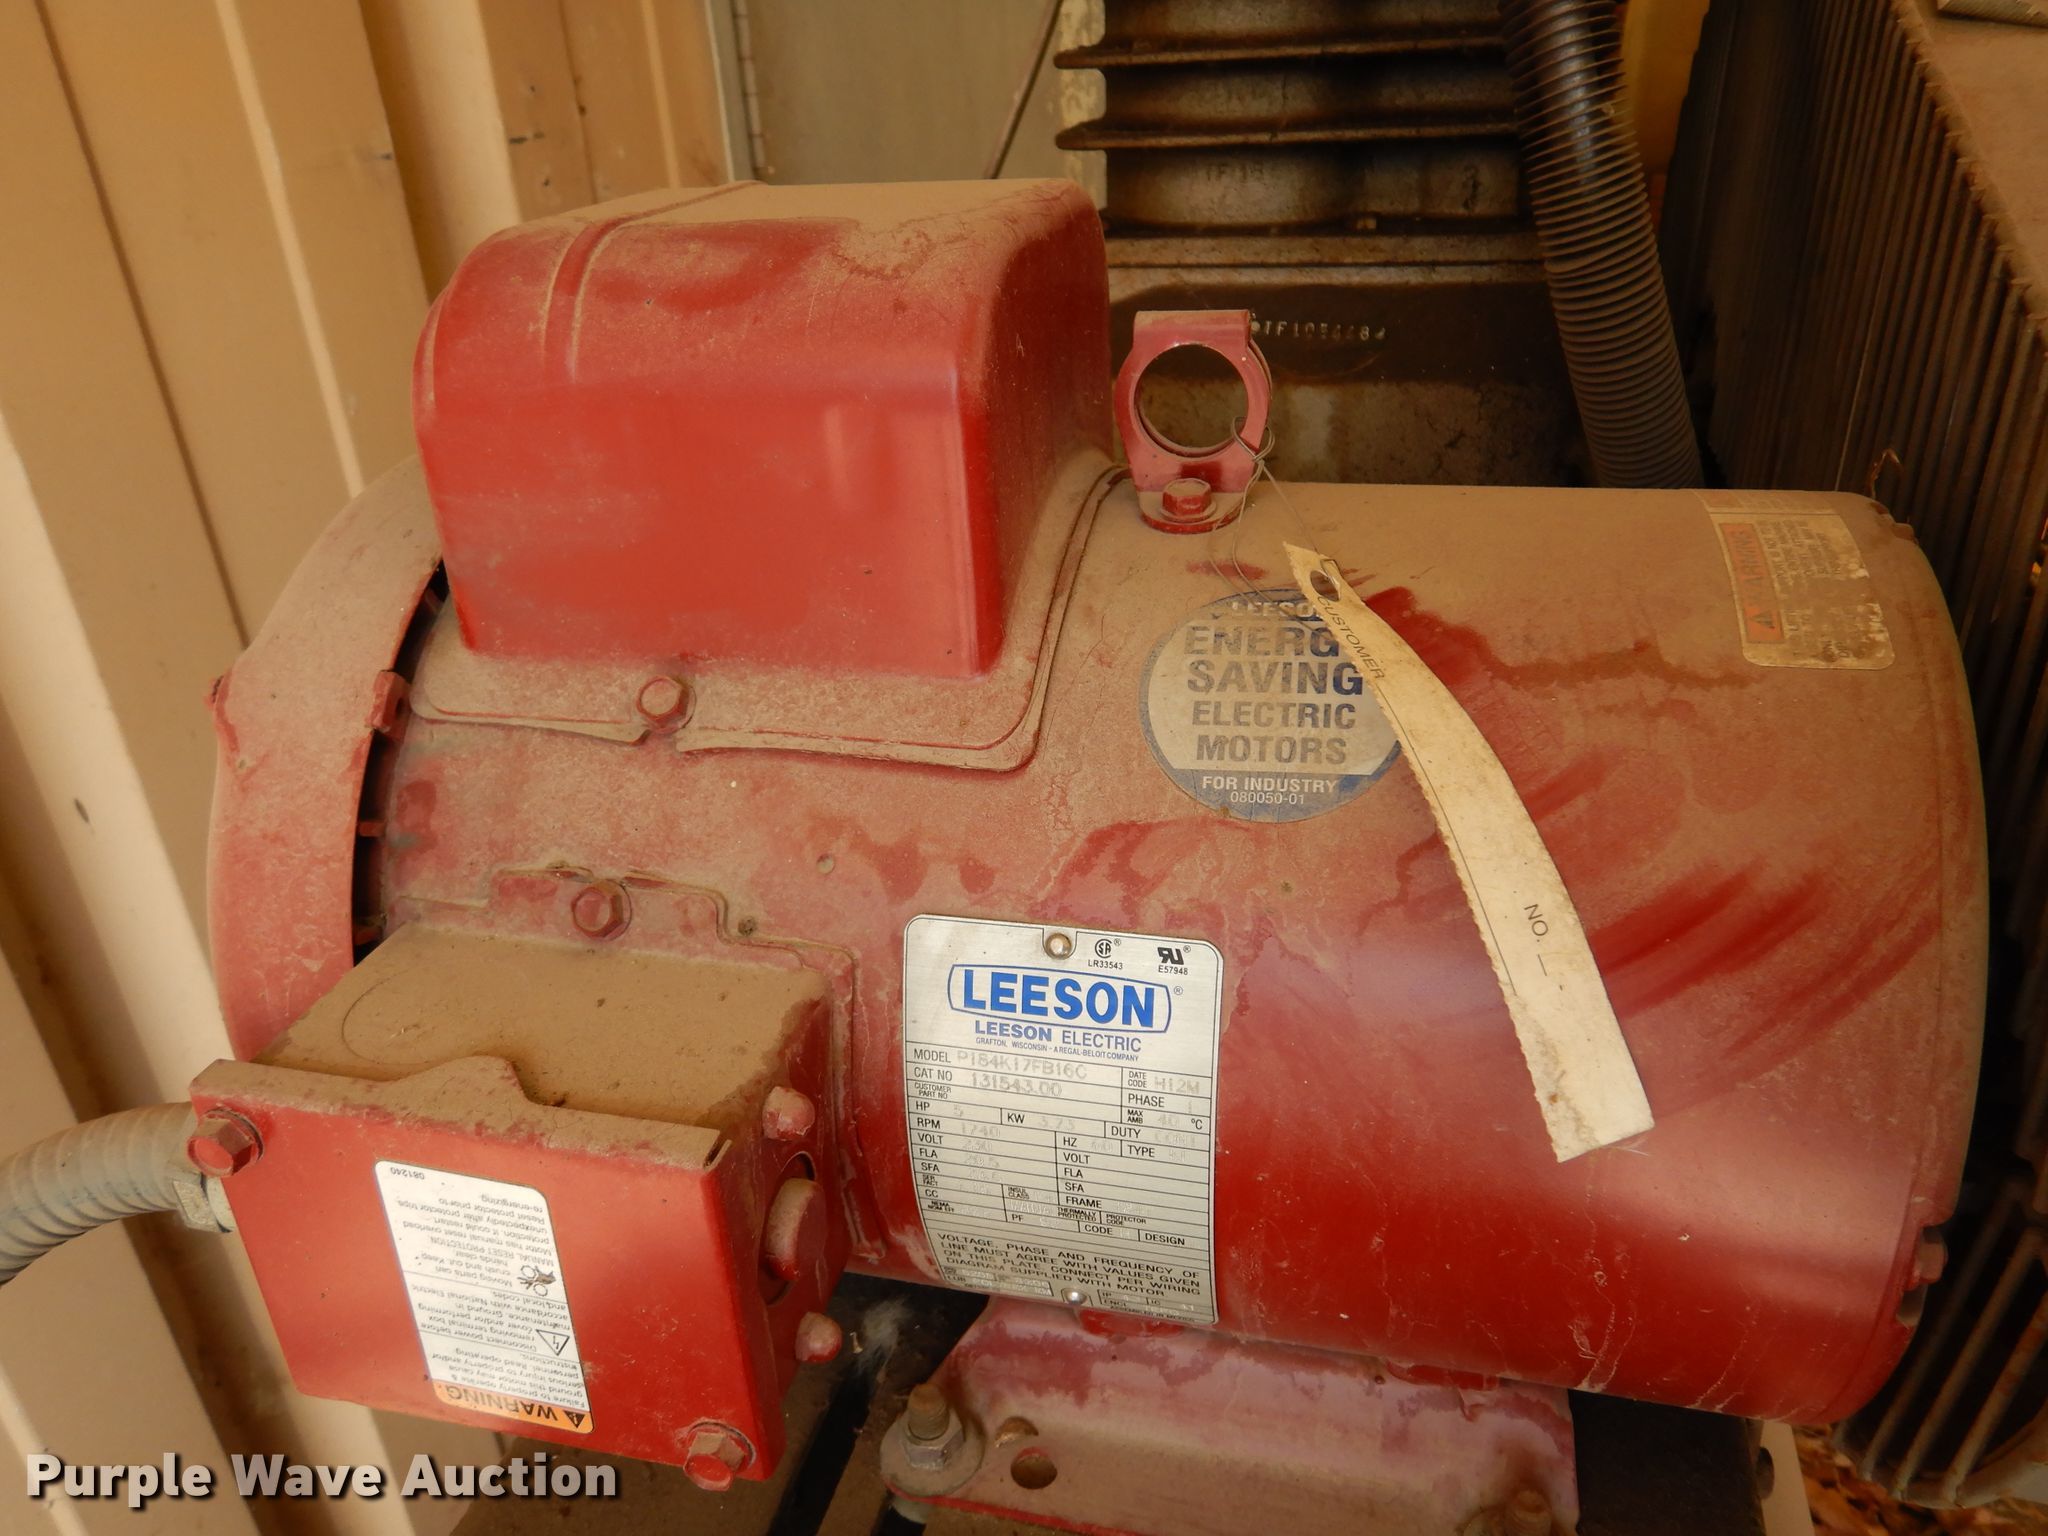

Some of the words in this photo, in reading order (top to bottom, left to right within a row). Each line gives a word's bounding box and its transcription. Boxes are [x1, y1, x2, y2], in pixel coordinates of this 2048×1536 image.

[1184, 626, 1339, 657] ENERG
[1317, 596, 1386, 680] CUSTOMER
[1187, 660, 1363, 695] SAVING
[1192, 701, 1355, 729] ELECTRIC
[1196, 735, 1347, 765] MOTORS
[1202, 776, 1238, 790] FOR
[1244, 777, 1337, 793] INDUSTRY
[1230, 792, 1304, 805] 080050-01
[1523, 903, 1549, 943] NO.
[1087, 959, 1124, 970] LR33543
[1158, 965, 1188, 976] E57948
[963, 969, 1155, 1028] LEESON
[975, 1021, 1052, 1042] LEESON
[1062, 1030, 1141, 1053] ELECTRIC
[914, 1049, 951, 1064] MODEL
[1012, 1041, 1048, 1051] WISCONSIN
[1107, 1052, 1139, 1062] COMPANY
[914, 1067, 935, 1081] CAT
[938, 1069, 953, 1082] NO
[1129, 1071, 1147, 1080] DATE
[914, 1082, 952, 1094] CUSTOMER
[1128, 1078, 1147, 1088] CODE
[918, 1089, 936, 1099] PART
[938, 1091, 948, 1100] NO
[1128, 1093, 1165, 1108] PHASE
[916, 1101, 929, 1111] HP
[1007, 1113, 1025, 1123] KW
[1128, 1109, 1143, 1117] MAX
[918, 1117, 940, 1129] RPM
[1111, 1126, 1141, 1138] DUTY
[918, 1133, 943, 1145] VOLT
[1063, 1136, 1077, 1148] HZ
[920, 1149, 937, 1158] FLA
[1128, 1145, 1155, 1158] TYPE
[1063, 1152, 1090, 1164] VOLT
[921, 1163, 940, 1172] SFA
[1064, 1168, 1083, 1178] FLA
[925, 1189, 938, 1197] CC
[1065, 1182, 1084, 1192] SFA
[1066, 1196, 1101, 1208] FRAME
[1058, 1207, 1096, 1216] THERMALLY
[1012, 1214, 1023, 1222] PF
[1106, 1214, 1146, 1224] PROTECTOR
[1085, 1225, 1112, 1235] CODE
[1145, 1233, 1185, 1245] DESIGN
[941, 1242, 968, 1250] LINE
[974, 1246, 1009, 1257] MUST
[1016, 1253, 1058, 1264] AGREE
[1063, 1260, 1098, 1271] WITH
[1103, 1267, 1153, 1279] VALUES
[1160, 1275, 1199, 1287] GIVEN
[1007, 1244, 1049, 1256] PHASE
[1058, 1251, 1085, 1261] AND
[1094, 1257, 1173, 1274] FREQUENCY
[947, 1257, 1005, 1271] DIAGRAM
[1010, 1267, 1072, 1281] SUPPLIED
[1078, 1278, 1111, 1288] WITH
[1117, 1284, 1164, 1296] MOTOR
[970, 1254, 995, 1262] THIS
[1051, 1266, 1110, 1281] CONNECT
[1118, 1277, 1143, 1286] PER
[1150, 1282, 1200, 1295] WIRING
[445, 1384, 558, 1422] WARNING
